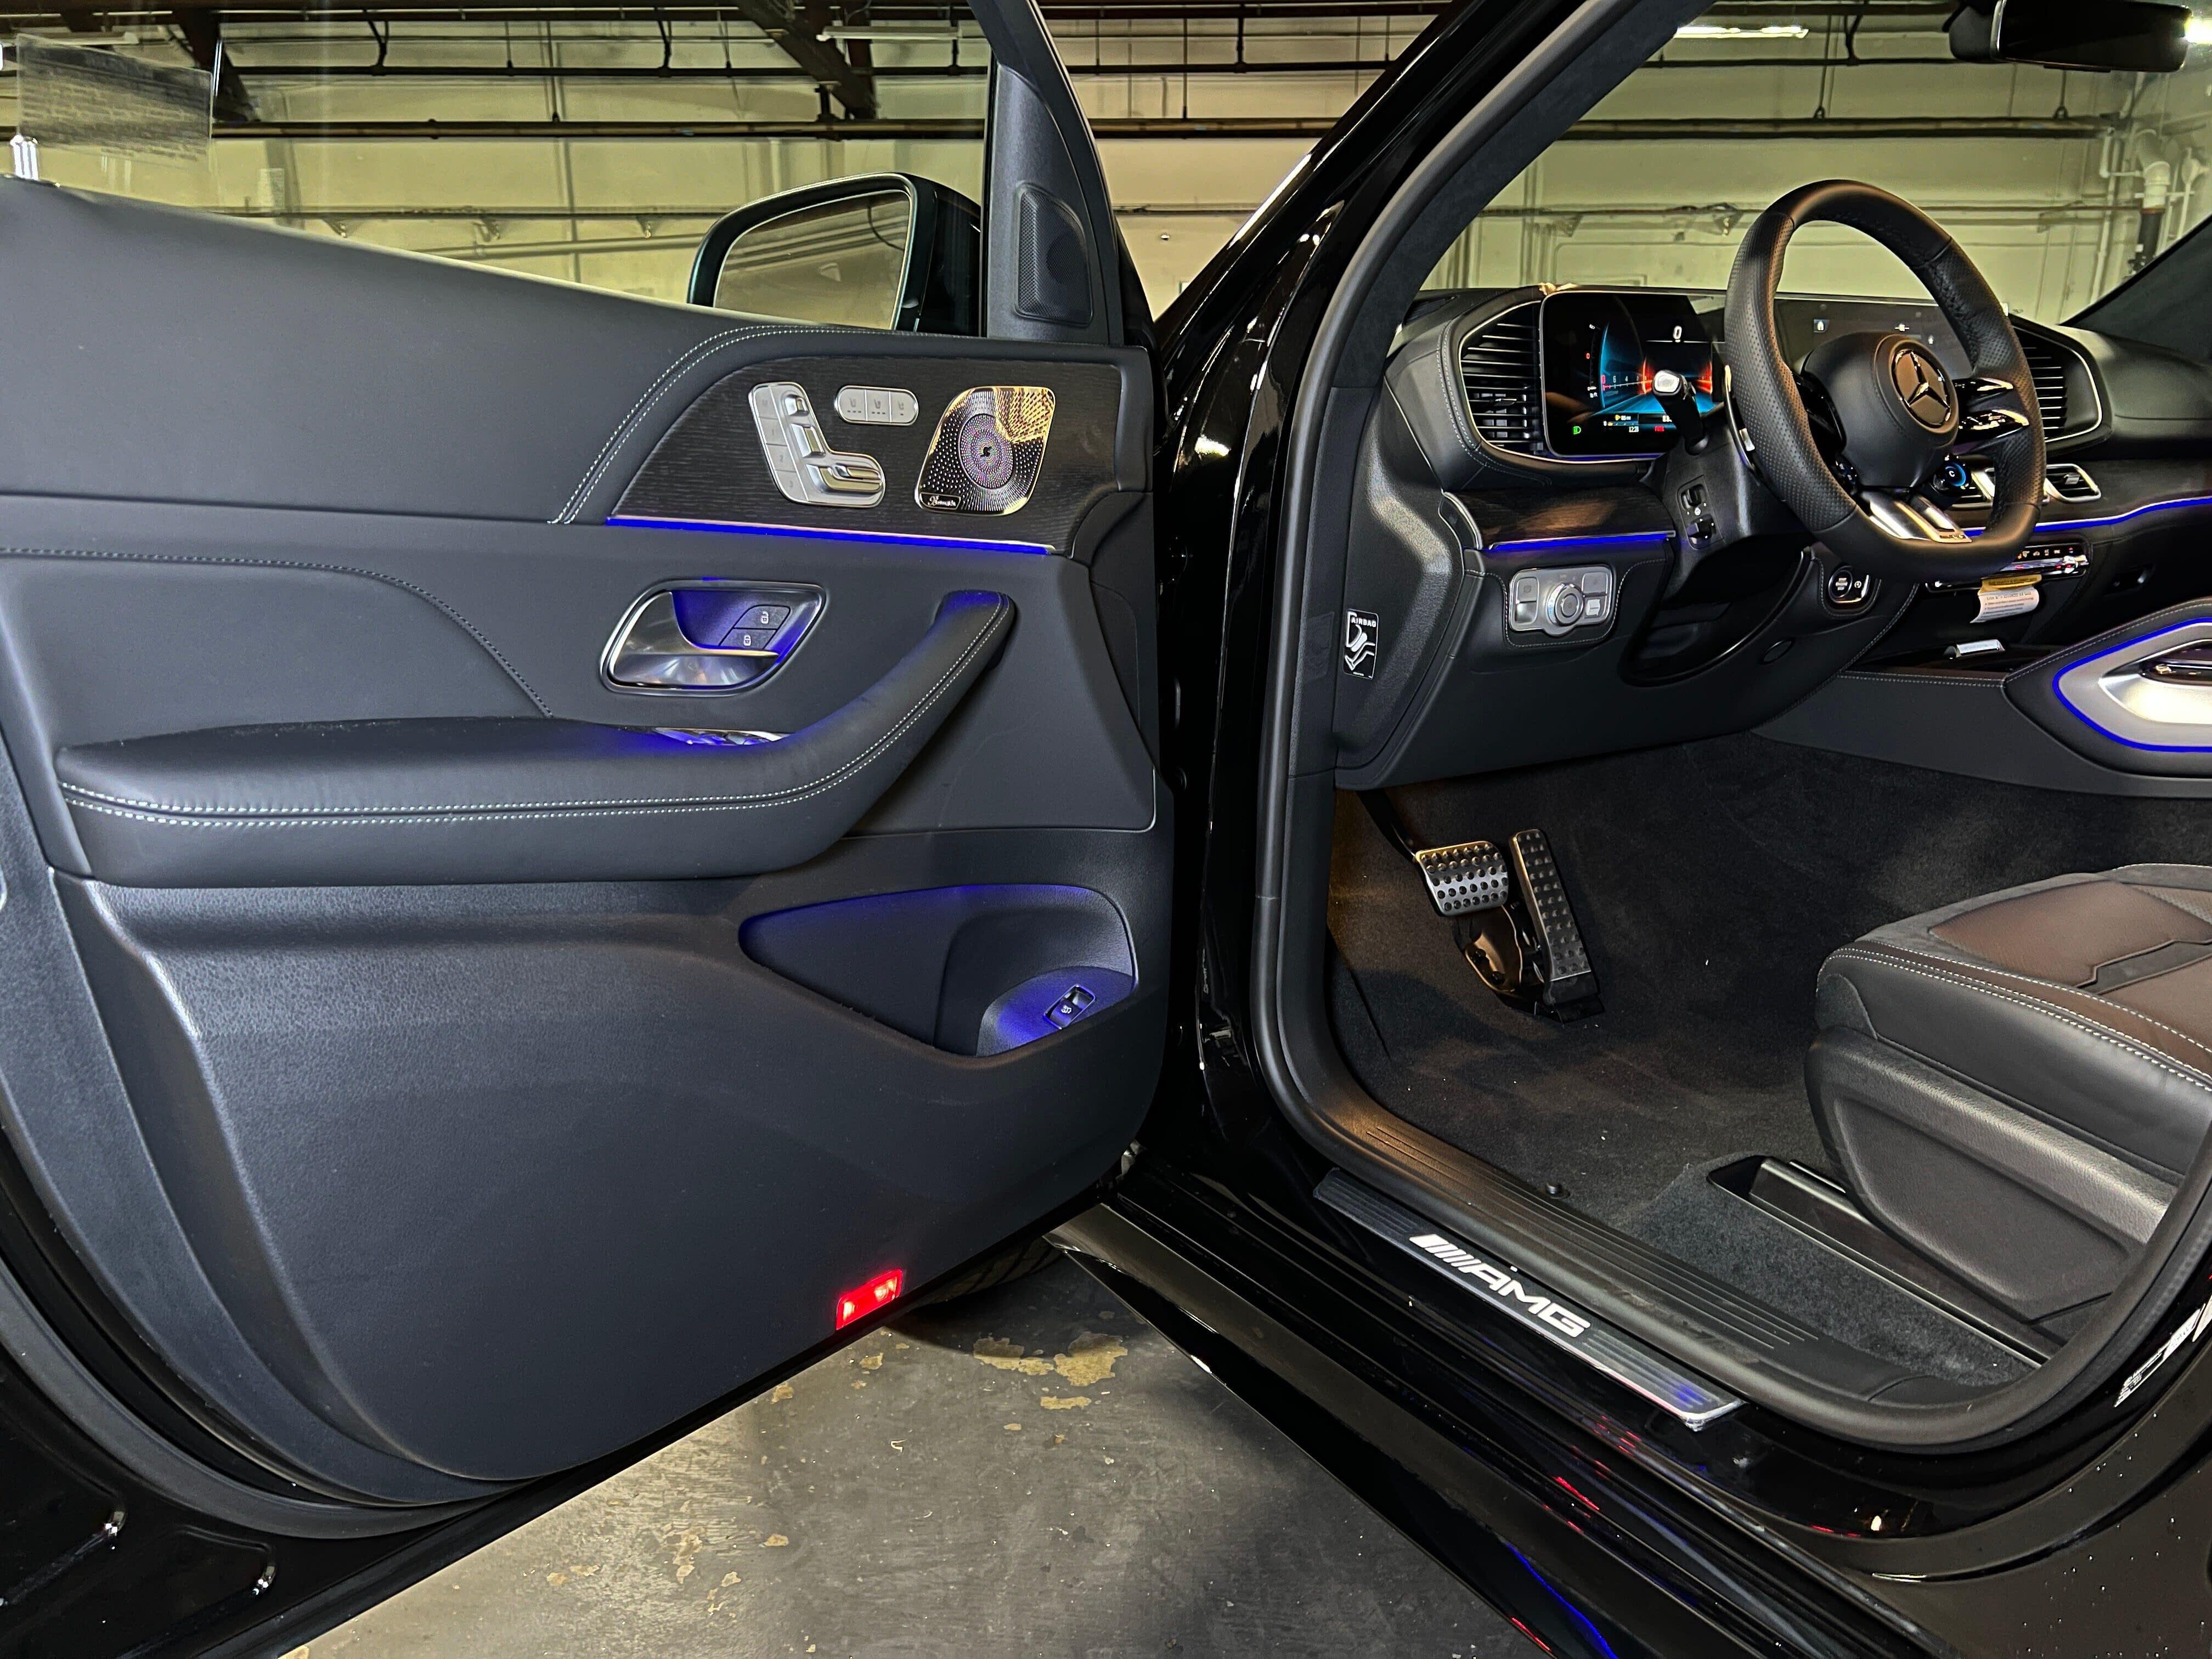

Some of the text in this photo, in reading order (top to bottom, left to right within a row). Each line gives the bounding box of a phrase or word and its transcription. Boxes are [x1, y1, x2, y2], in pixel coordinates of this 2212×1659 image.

[1673, 325, 1682, 339] 0
[1351, 617, 1377, 628] AIRBAG
[1457, 1259, 1592, 1338] AMG
